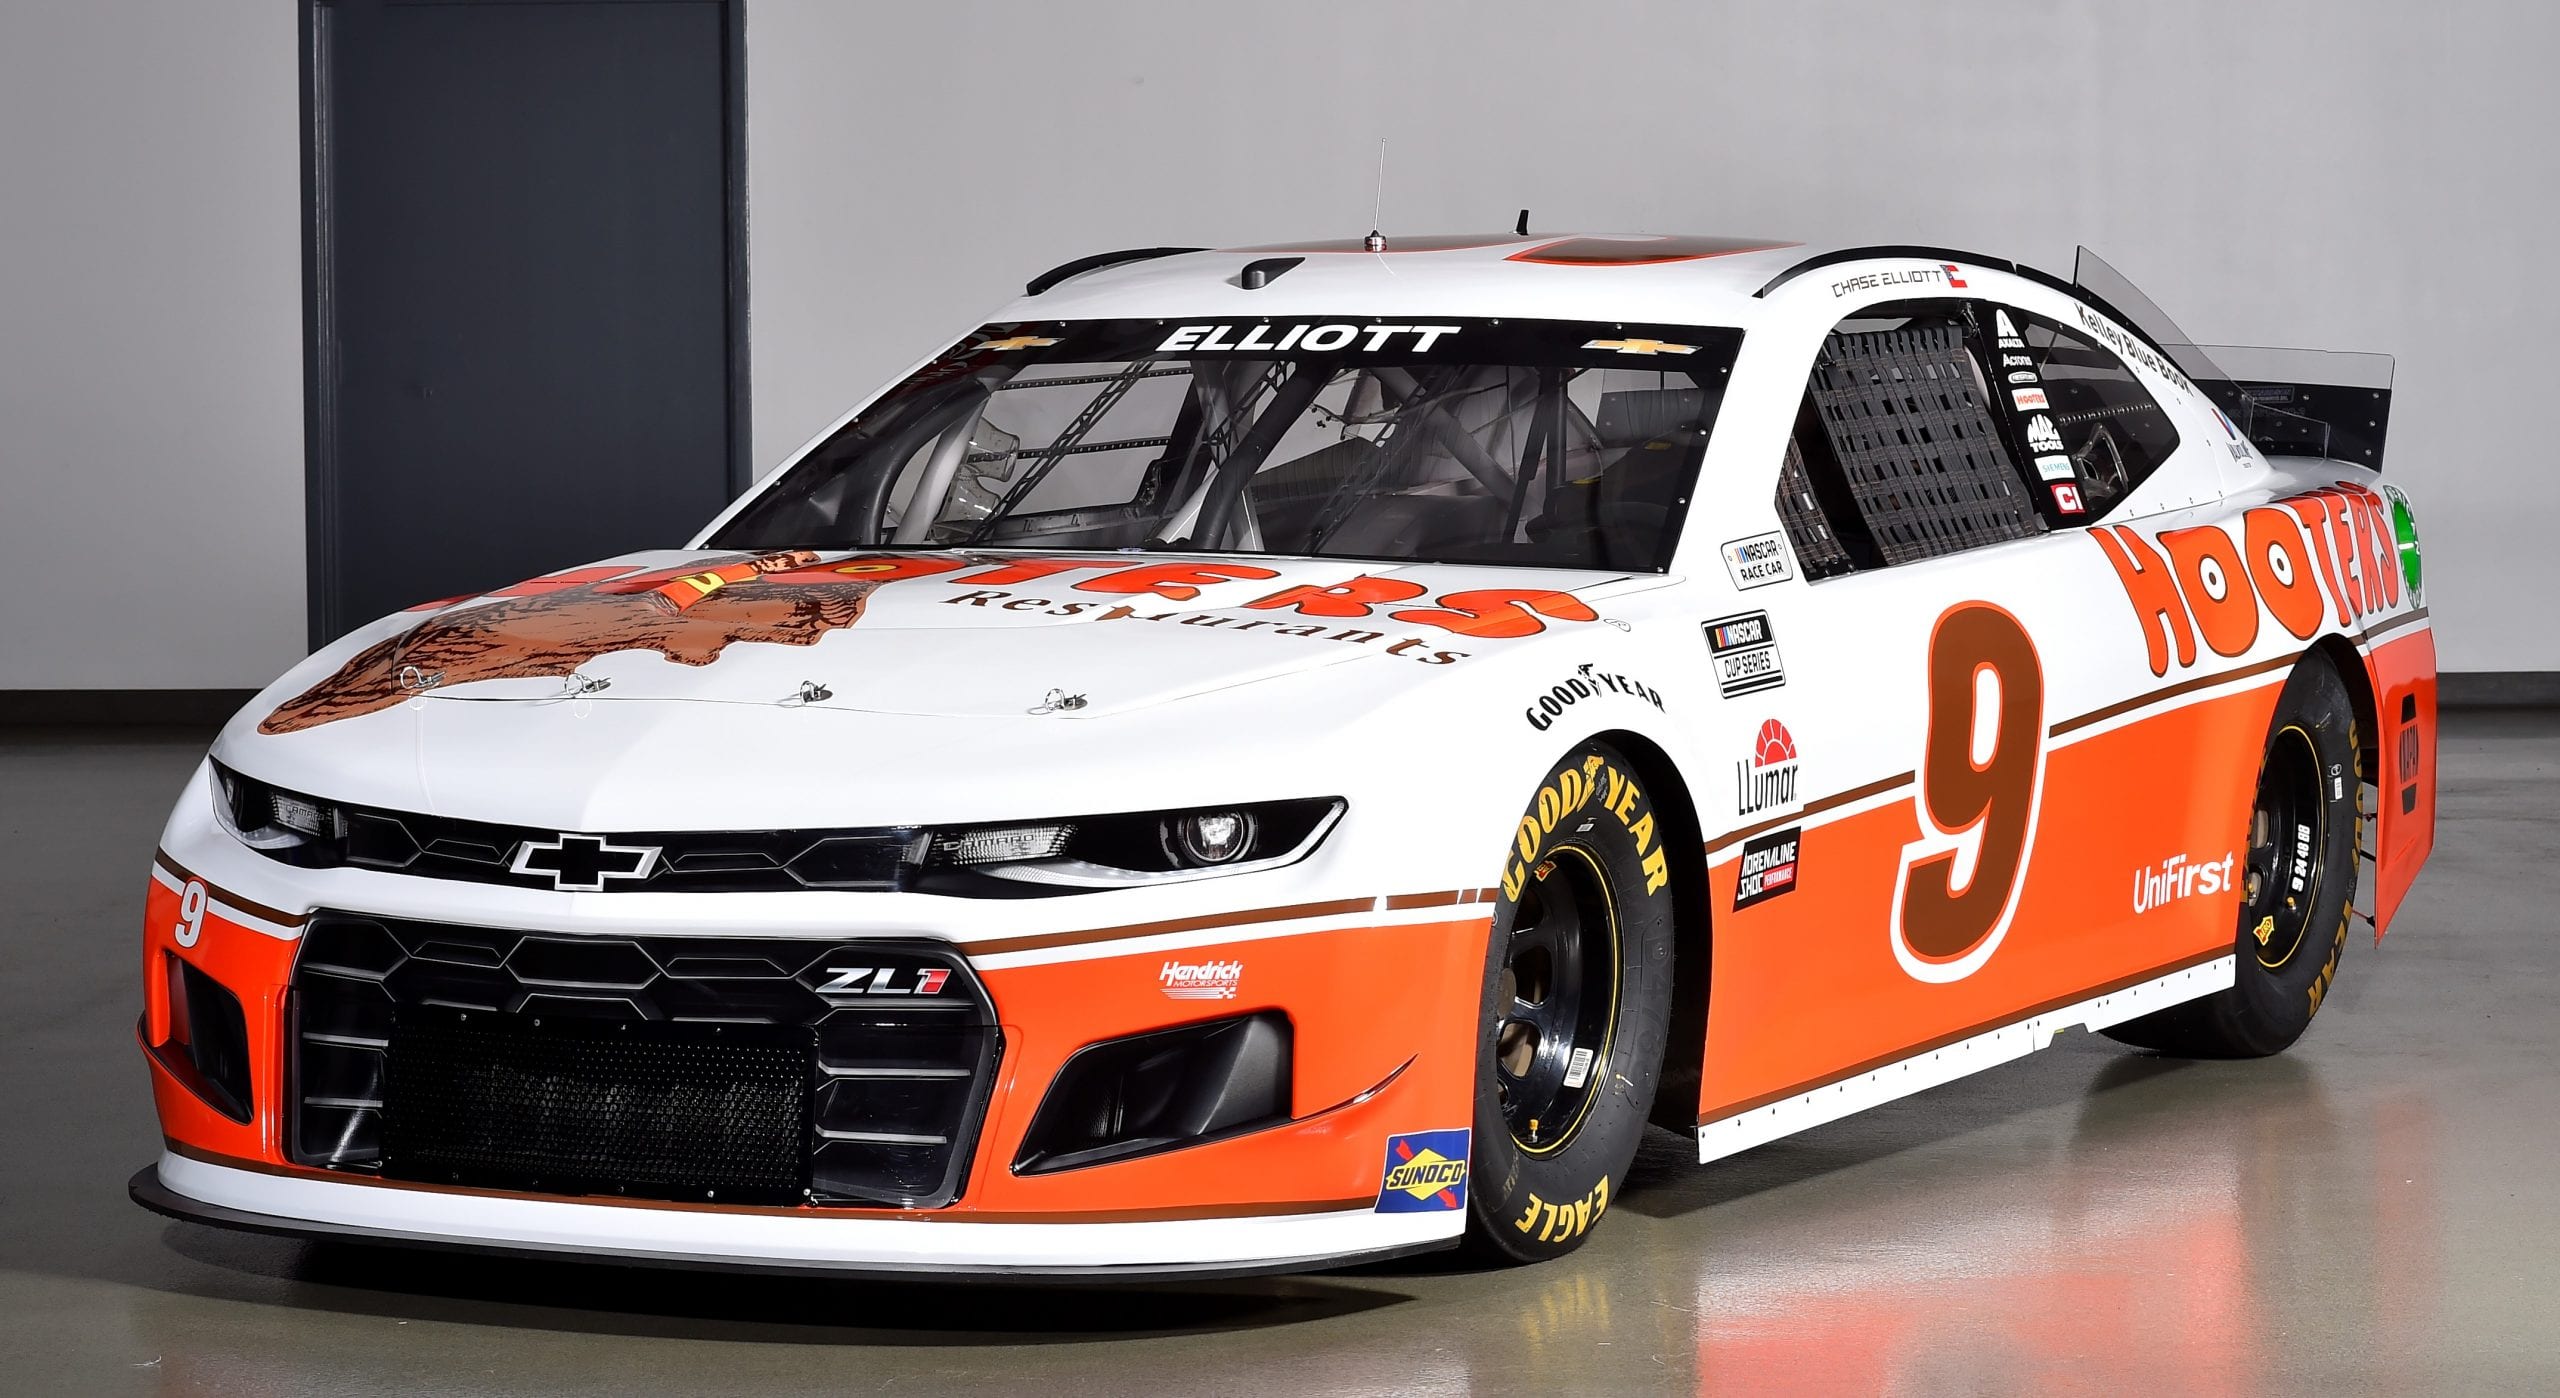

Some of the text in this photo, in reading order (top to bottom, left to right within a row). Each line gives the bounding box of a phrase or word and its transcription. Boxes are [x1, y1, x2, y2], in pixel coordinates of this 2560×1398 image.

[1832, 270, 1941, 298] CHASE ELLIOTT
[1156, 324, 1462, 352] ELLIOTT
[2074, 302, 2124, 355] Kelley
[2121, 333, 2157, 372] Blue
[2027, 414, 2061, 442] MAC
[2030, 440, 2064, 453] TOOLS
[2042, 462, 2071, 473] SIEMENS
[1743, 539, 1779, 562] NASCAR
[1740, 560, 1784, 581] RACE CAR
[2086, 480, 2398, 678] HOOTERS
[1726, 619, 1763, 646] NASCAR
[1724, 651, 1771, 678] CUP SERIES
[1900, 600, 2044, 965] 9
[1741, 841, 1797, 877] ADRENALINE
[2294, 858, 2308, 878] 24
[1737, 872, 1764, 901] SHOC
[2133, 850, 2234, 914] UniFirst
[175, 876, 208, 948] 9
[815, 968, 951, 994] ZL1
[1159, 960, 1243, 986] Hendrick
[1173, 979, 1238, 987] MOTORSPORTS
[1389, 1162, 1465, 1187] SUNOCO
[1514, 1174, 1610, 1243] EAGLE
